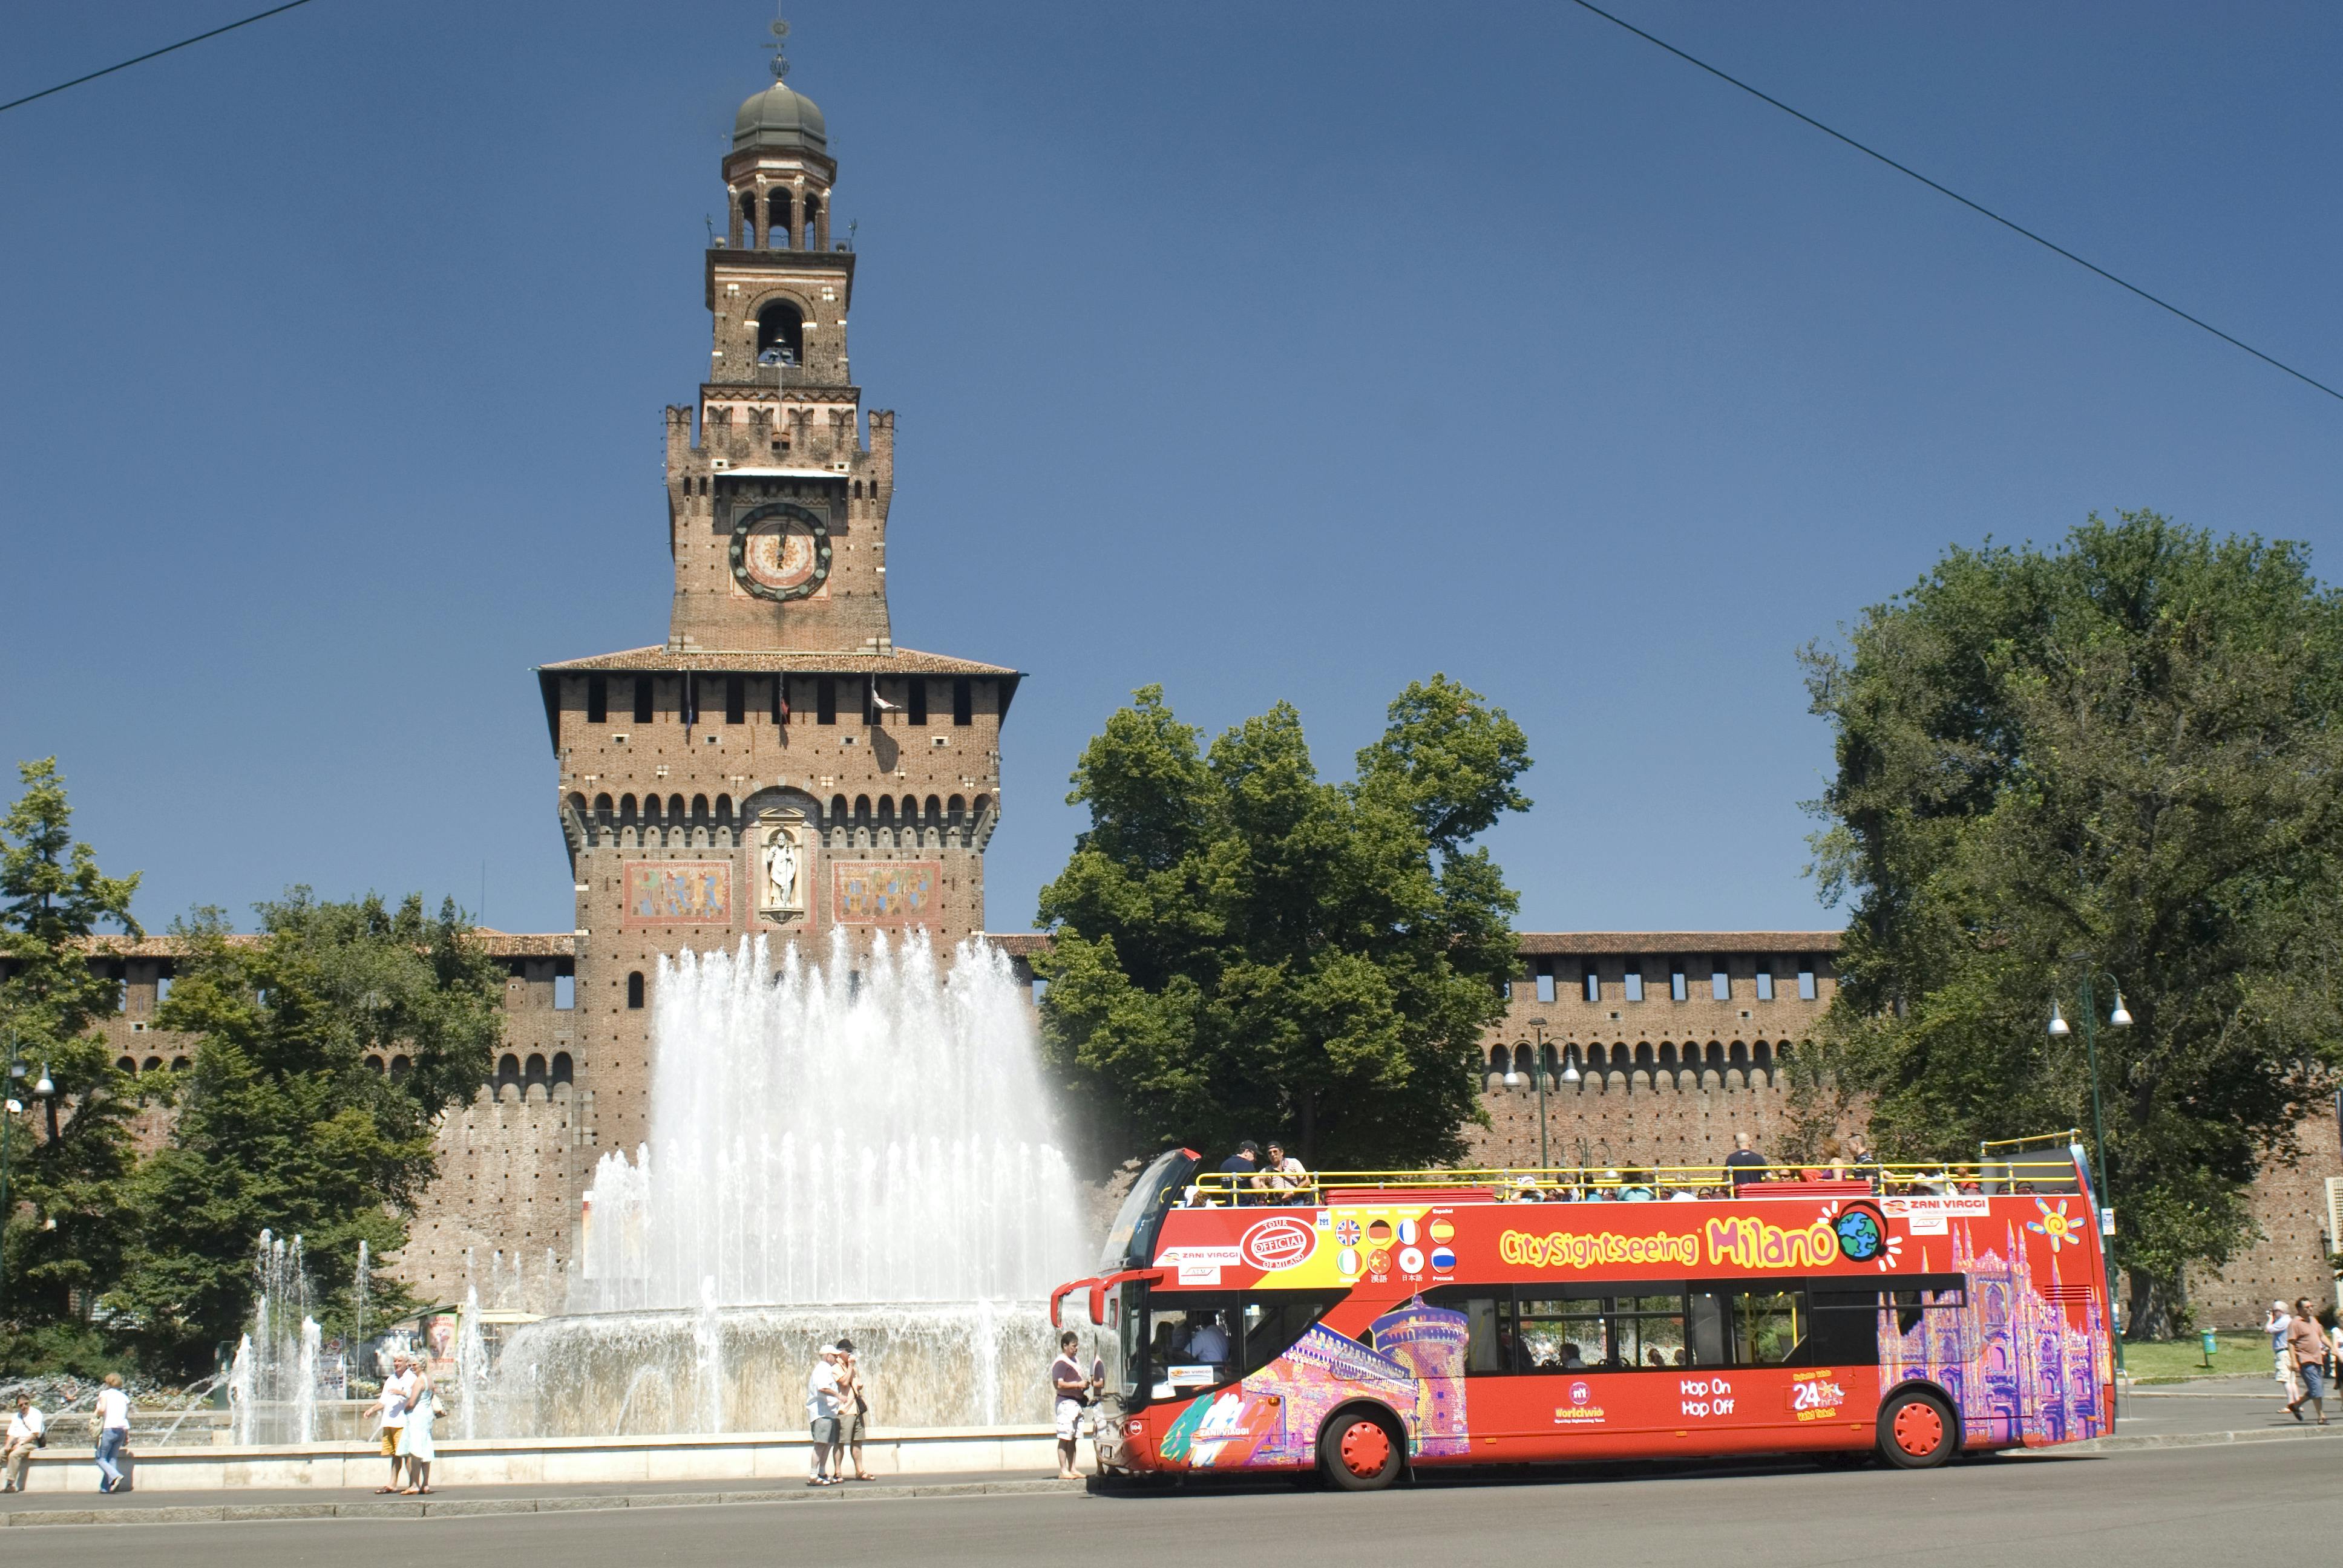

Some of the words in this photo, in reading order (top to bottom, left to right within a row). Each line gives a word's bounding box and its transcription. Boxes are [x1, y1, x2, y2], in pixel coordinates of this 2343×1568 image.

[1910, 1200, 1940, 1209] ZANI
[1942, 1200, 1986, 1209] VIAGGI
[1262, 1219, 1288, 1230] TOUR
[1254, 1235, 1305, 1254] OFFICIAL
[1499, 1230, 1699, 1269] CitySightseeing
[1706, 1216, 1839, 1268] Milano
[1262, 1260, 1275, 1269] OF
[1276, 1253, 1305, 1269] MILANO
[1681, 1380, 1709, 1397] Hop
[1712, 1378, 1731, 1395] On
[1794, 1382, 1821, 1410] 24
[1682, 1400, 1709, 1418] Hop
[1713, 1399, 1735, 1416] Off
